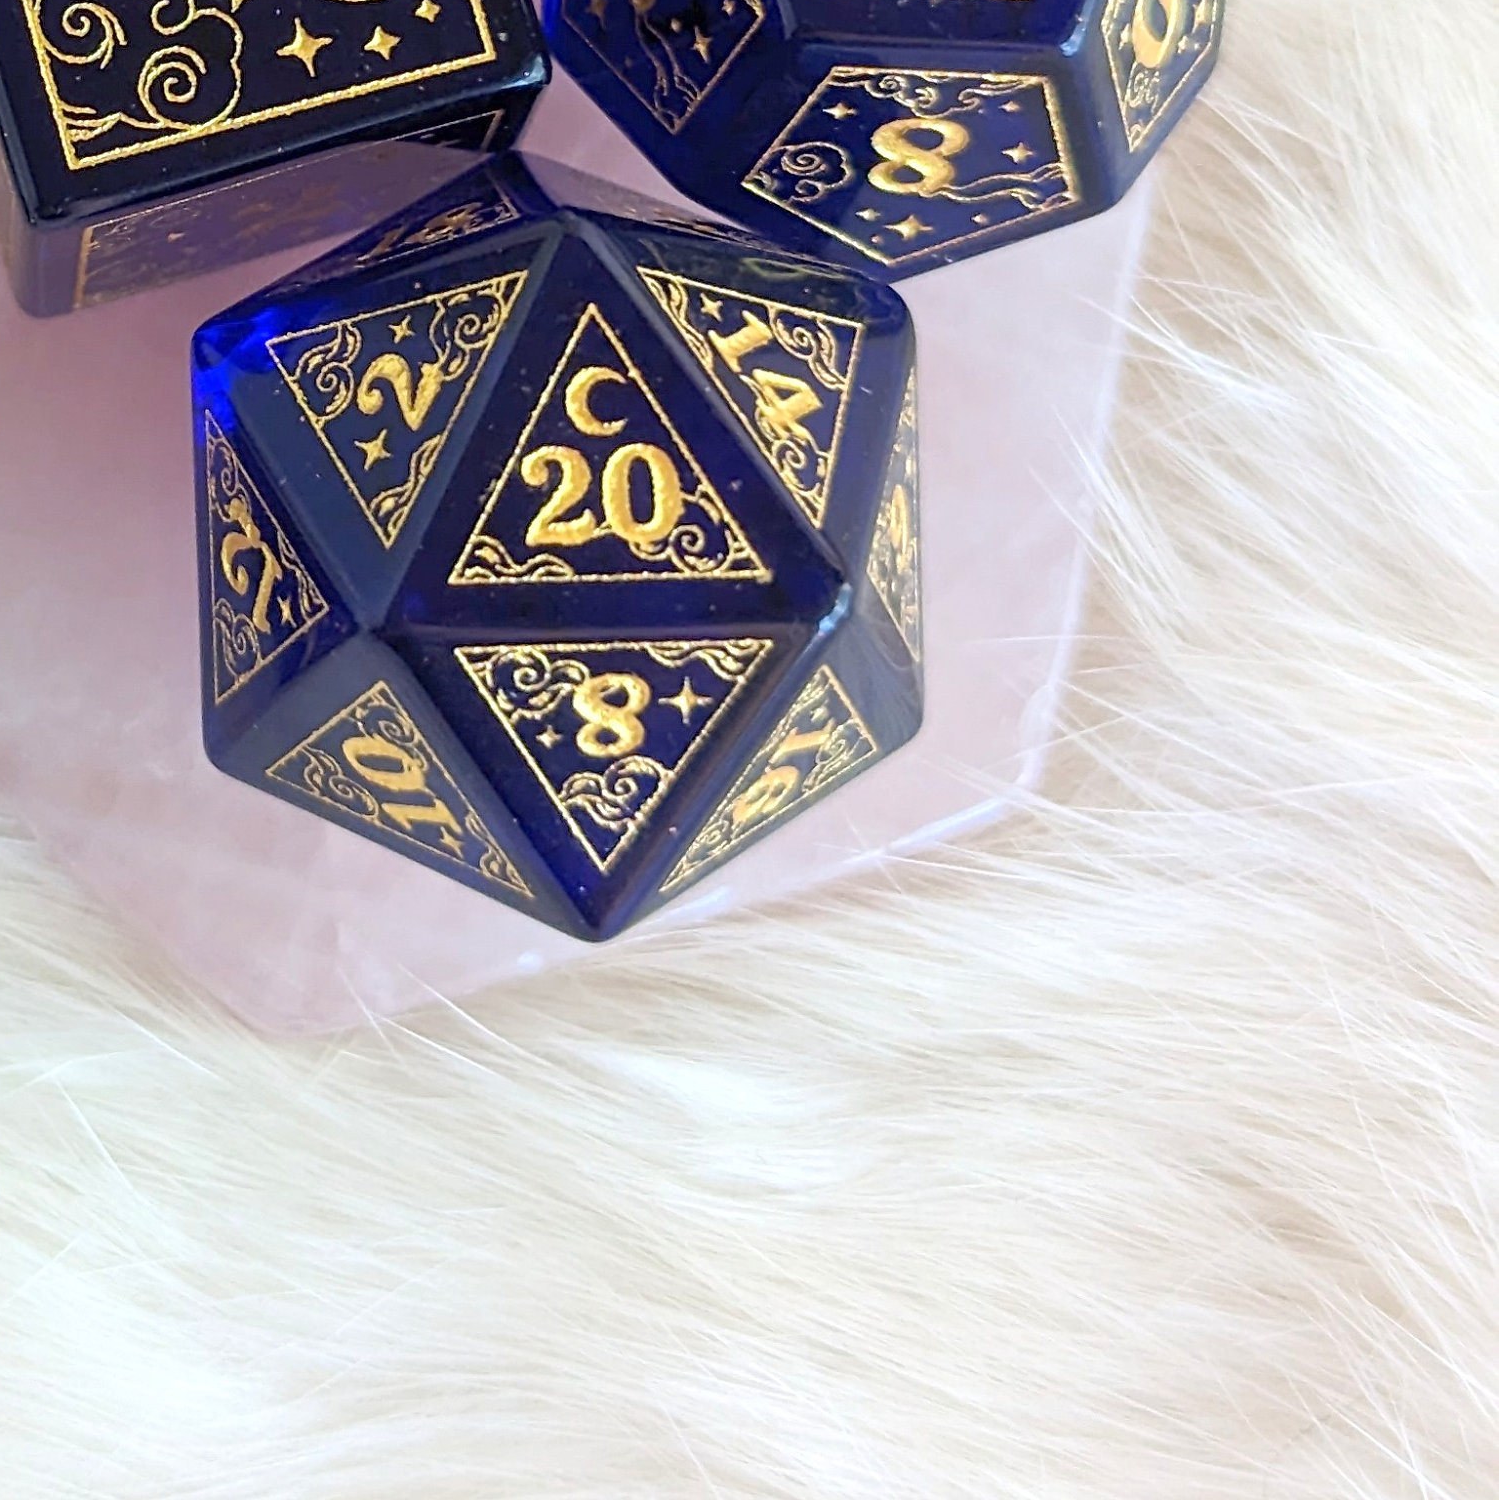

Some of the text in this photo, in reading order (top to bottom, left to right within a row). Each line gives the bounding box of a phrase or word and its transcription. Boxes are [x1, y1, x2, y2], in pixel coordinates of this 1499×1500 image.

[867, 117, 971, 195] 8
[356, 352, 441, 432] 2
[707, 308, 825, 441] 14
[520, 442, 685, 548] 20
[572, 671, 651, 759] 8
[343, 735, 459, 842] 10
